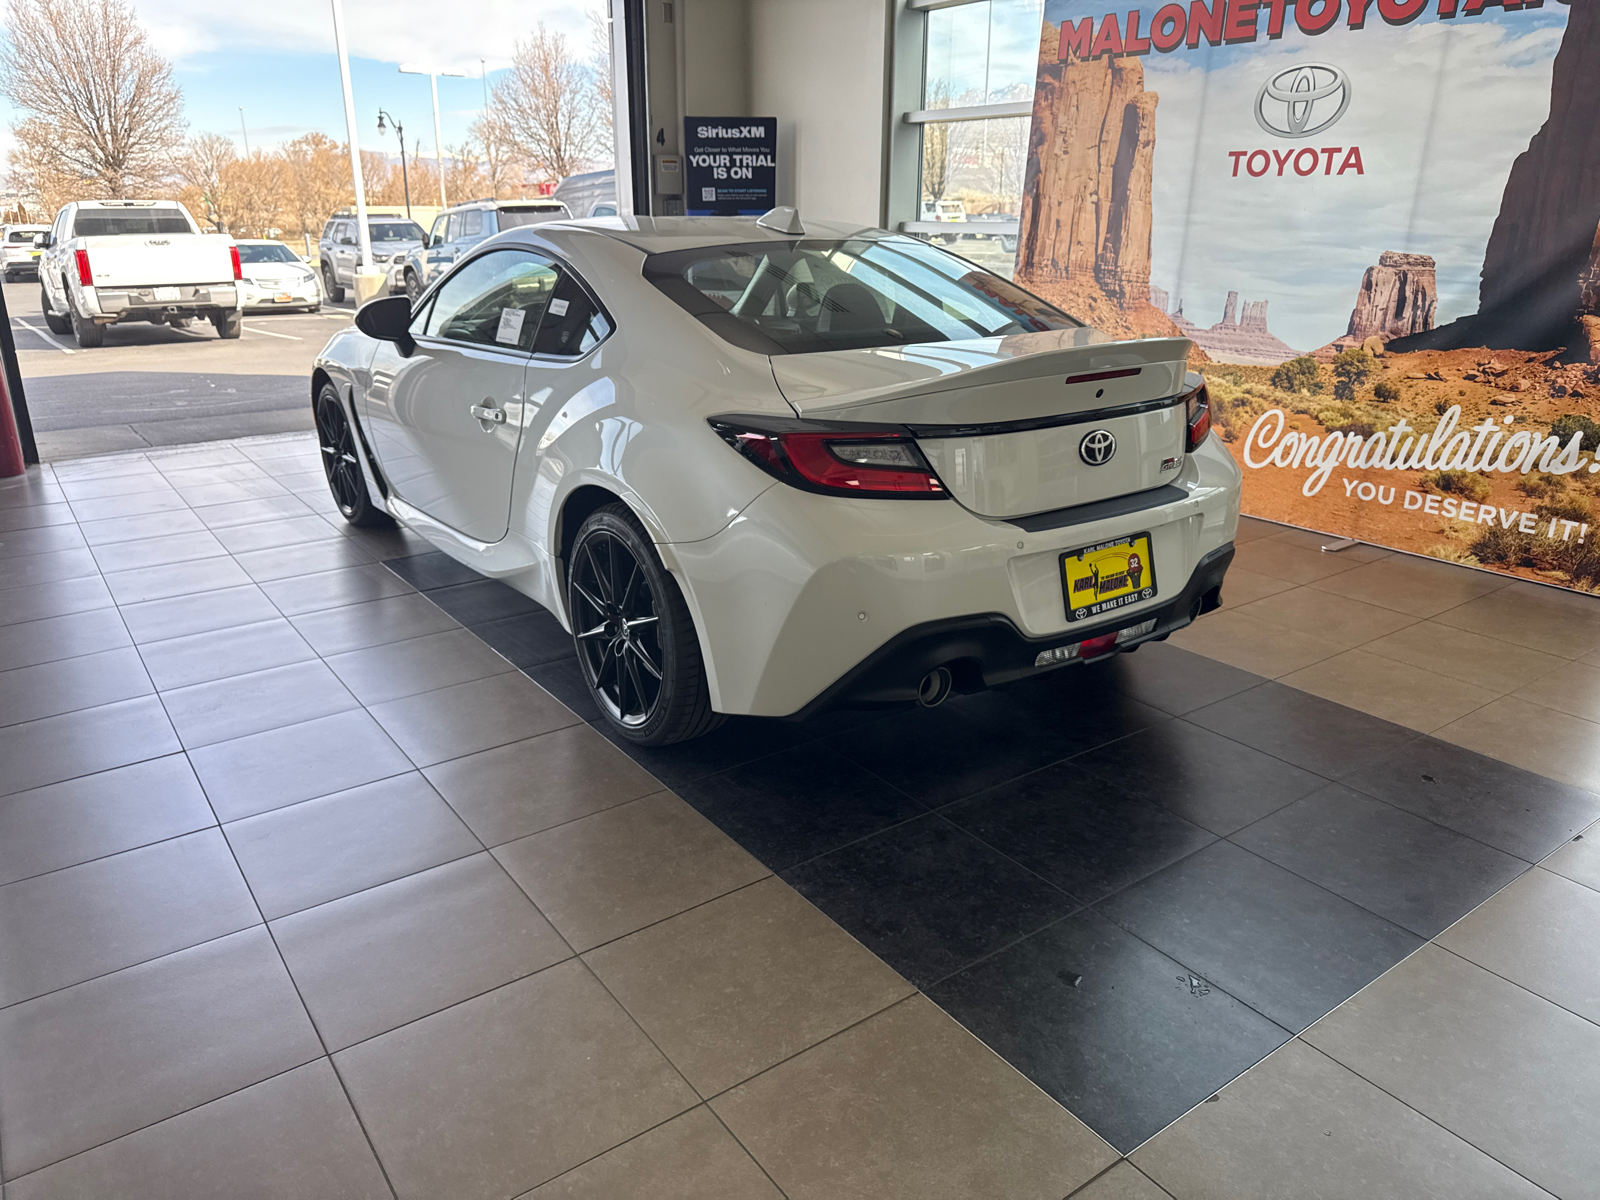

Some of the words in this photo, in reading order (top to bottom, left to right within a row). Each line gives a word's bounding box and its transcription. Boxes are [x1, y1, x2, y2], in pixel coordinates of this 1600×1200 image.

[656, 127, 665, 146] 4
[697, 126, 765, 138] SiriusXM
[689, 155, 731, 167] YOUR
[733, 155, 776, 167] TRIAL
[1228, 146, 1365, 178] TOYOTA
[713, 167, 728, 179] IS
[730, 167, 753, 179] ON
[1342, 477, 1396, 505] YOU
[1402, 489, 1539, 534] DESERVE
[1547, 517, 1589, 545] IT!
[1083, 545, 1096, 554] KARL
[1130, 558, 1138, 568] 32
[1073, 575, 1094, 594] KARL
[1099, 575, 1128, 595] MALONE
[1091, 604, 1101, 614] WE
[1101, 600, 1117, 611] MAKE
[1118, 598, 1124, 606] IT
[1124, 593, 1138, 603] EASY
